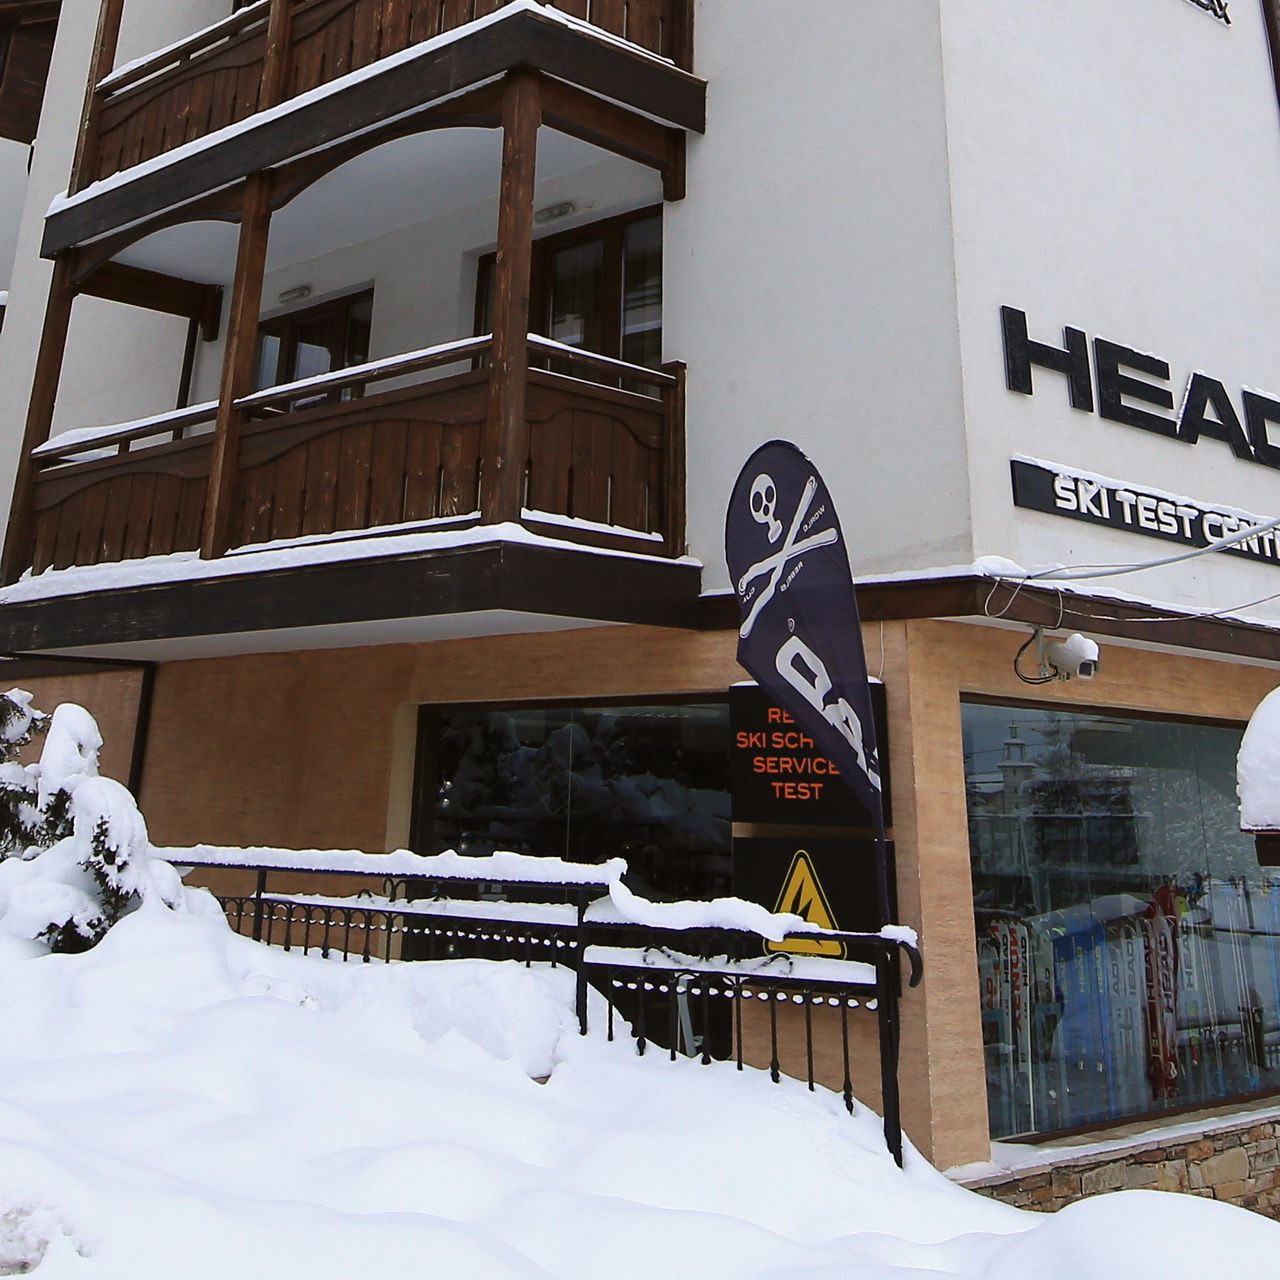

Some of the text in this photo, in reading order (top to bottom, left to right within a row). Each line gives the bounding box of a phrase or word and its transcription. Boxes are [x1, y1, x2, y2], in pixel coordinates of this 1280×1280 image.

[1053, 473, 1110, 519] SKI
[1114, 488, 1200, 539] TEST
[736, 732, 766, 749] SKI
[752, 755, 841, 775] SERVICE
[771, 782, 824, 800] TEST
